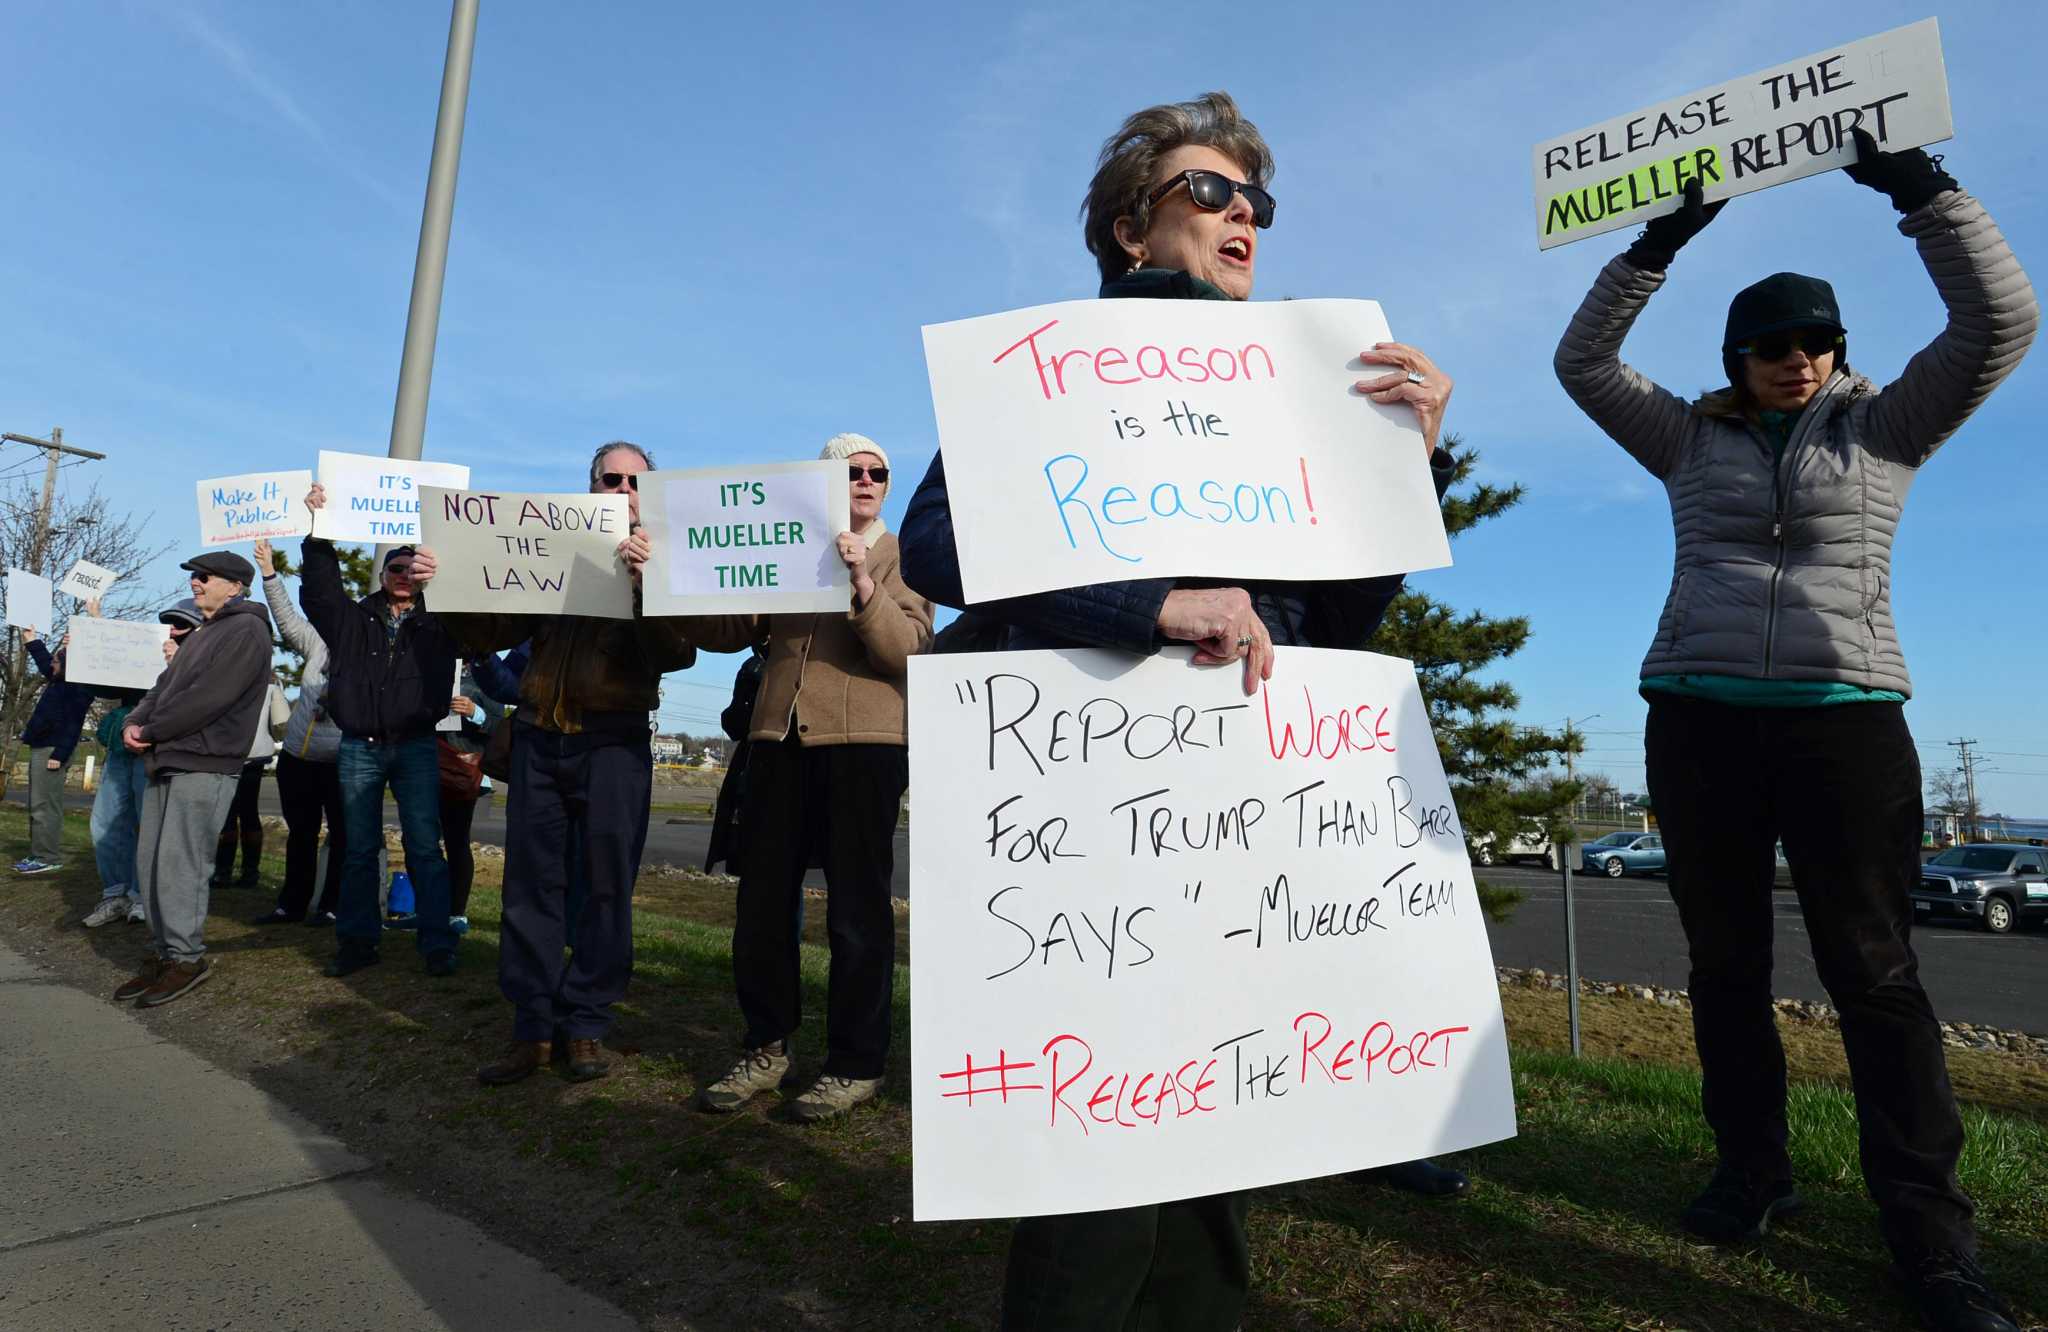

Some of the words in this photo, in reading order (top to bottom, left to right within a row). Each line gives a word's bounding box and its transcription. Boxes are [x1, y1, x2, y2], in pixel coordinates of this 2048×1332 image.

[1545, 92, 1734, 179] RELEASE
[1760, 54, 1856, 111] THE
[1545, 148, 1721, 235] MUELLER
[1731, 91, 1908, 179] REPORT
[992, 320, 1276, 400] Treason
[1112, 409, 1146, 440] is
[1163, 400, 1230, 437] the
[211, 488, 256, 509] Make
[263, 482, 280, 500] It
[351, 496, 421, 514] MUELLE
[444, 494, 500, 526] NOT
[518, 499, 618, 533] ABOVE
[720, 482, 766, 507] IT'S
[1044, 454, 1319, 562] Reason!
[369, 521, 415, 536] TIME
[496, 535, 550, 557] THE
[687, 521, 805, 549] MUELLER
[483, 565, 565, 592] LAW
[714, 563, 779, 588] TIME
[955, 674, 1250, 776] "REPORT
[1264, 683, 1397, 760] WORSE
[985, 795, 1085, 863] FOR
[1111, 788, 1265, 858] TRUMP
[1283, 780, 1378, 855] THAN
[1387, 776, 1456, 850] BARR
[1383, 862, 1456, 917] TEAM
